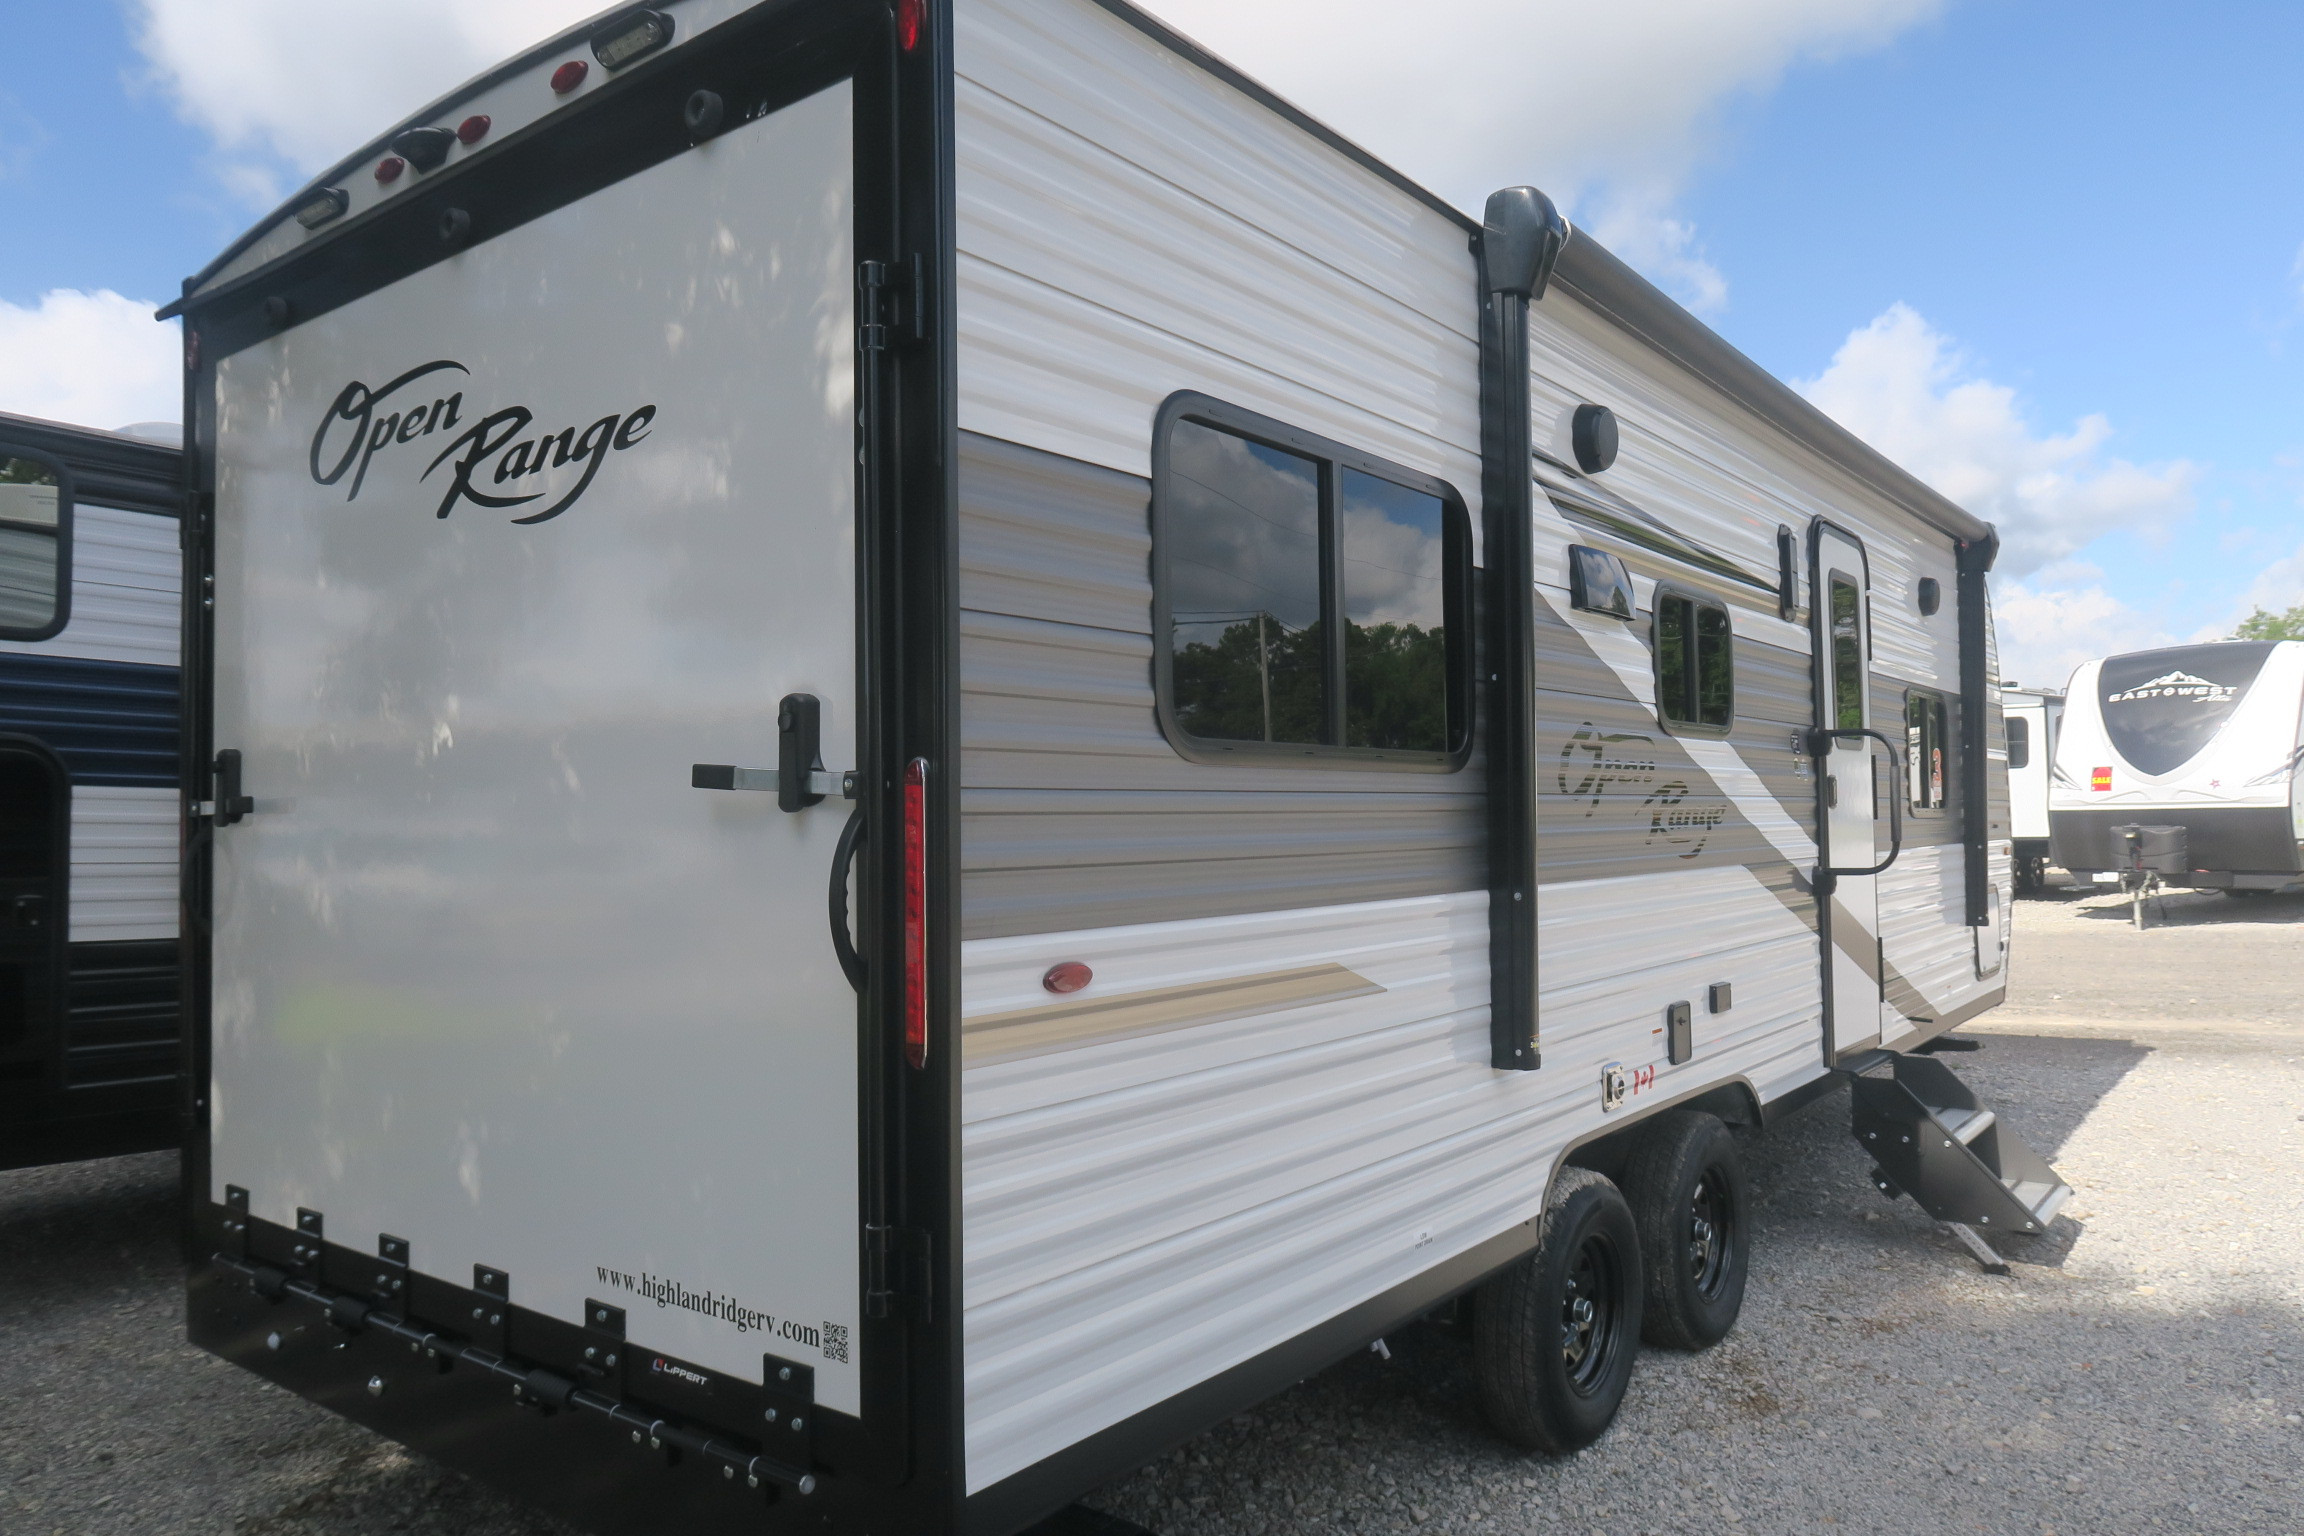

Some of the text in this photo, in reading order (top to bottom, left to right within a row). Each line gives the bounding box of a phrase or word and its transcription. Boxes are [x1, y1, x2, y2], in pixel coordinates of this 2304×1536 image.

[310, 360, 471, 502] Open
[420, 405, 657, 525] Range
[2108, 689, 2161, 702] EAST
[2177, 686, 2237, 695] WEST
[1558, 721, 1655, 818] Open
[1635, 780, 1727, 860] Range
[597, 1266, 820, 1347] www.highlandridgerv.com
